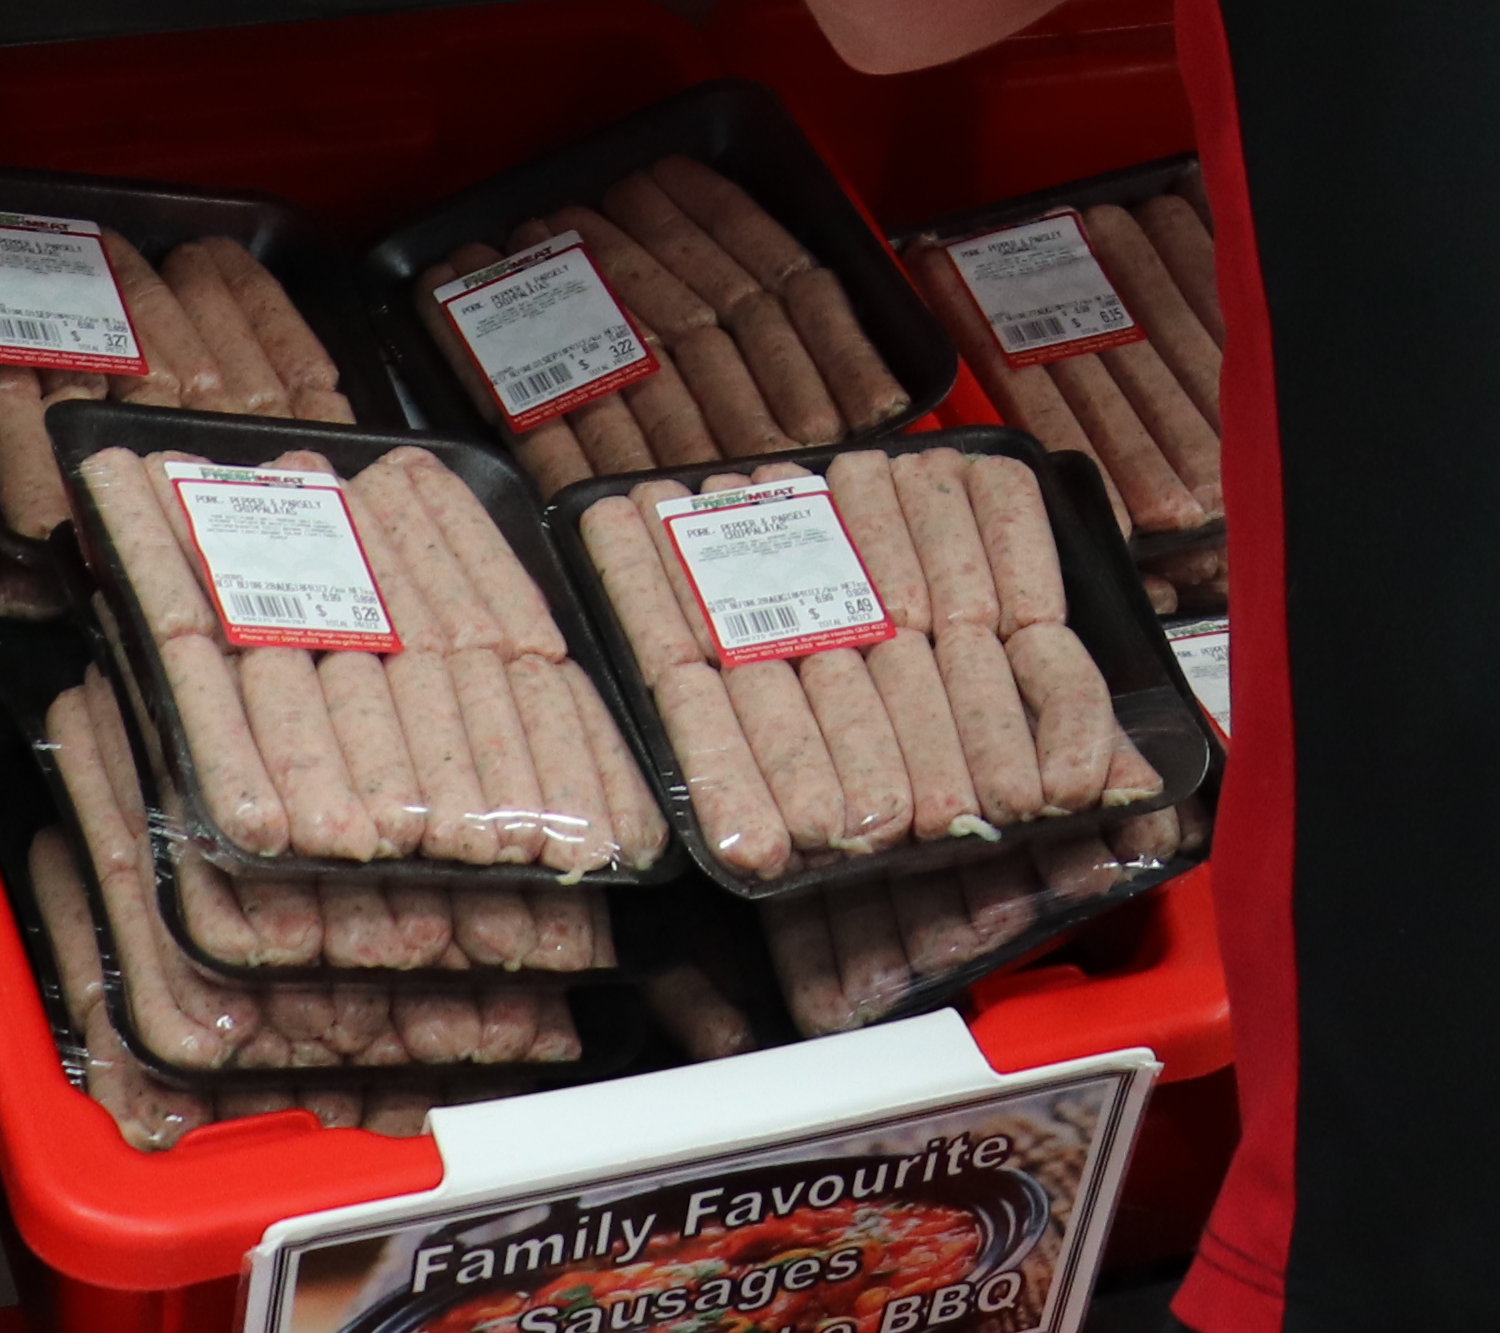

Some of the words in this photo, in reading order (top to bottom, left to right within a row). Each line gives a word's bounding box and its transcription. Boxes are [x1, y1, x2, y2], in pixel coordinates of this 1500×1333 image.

[808, 608, 820, 620] $
[845, 598, 874, 614] 6.49
[411, 1210, 656, 1295] Family
[682, 1133, 1013, 1237] Favourite
[513, 1246, 863, 1333] Sausages
[878, 1270, 1024, 1333] BBQ
